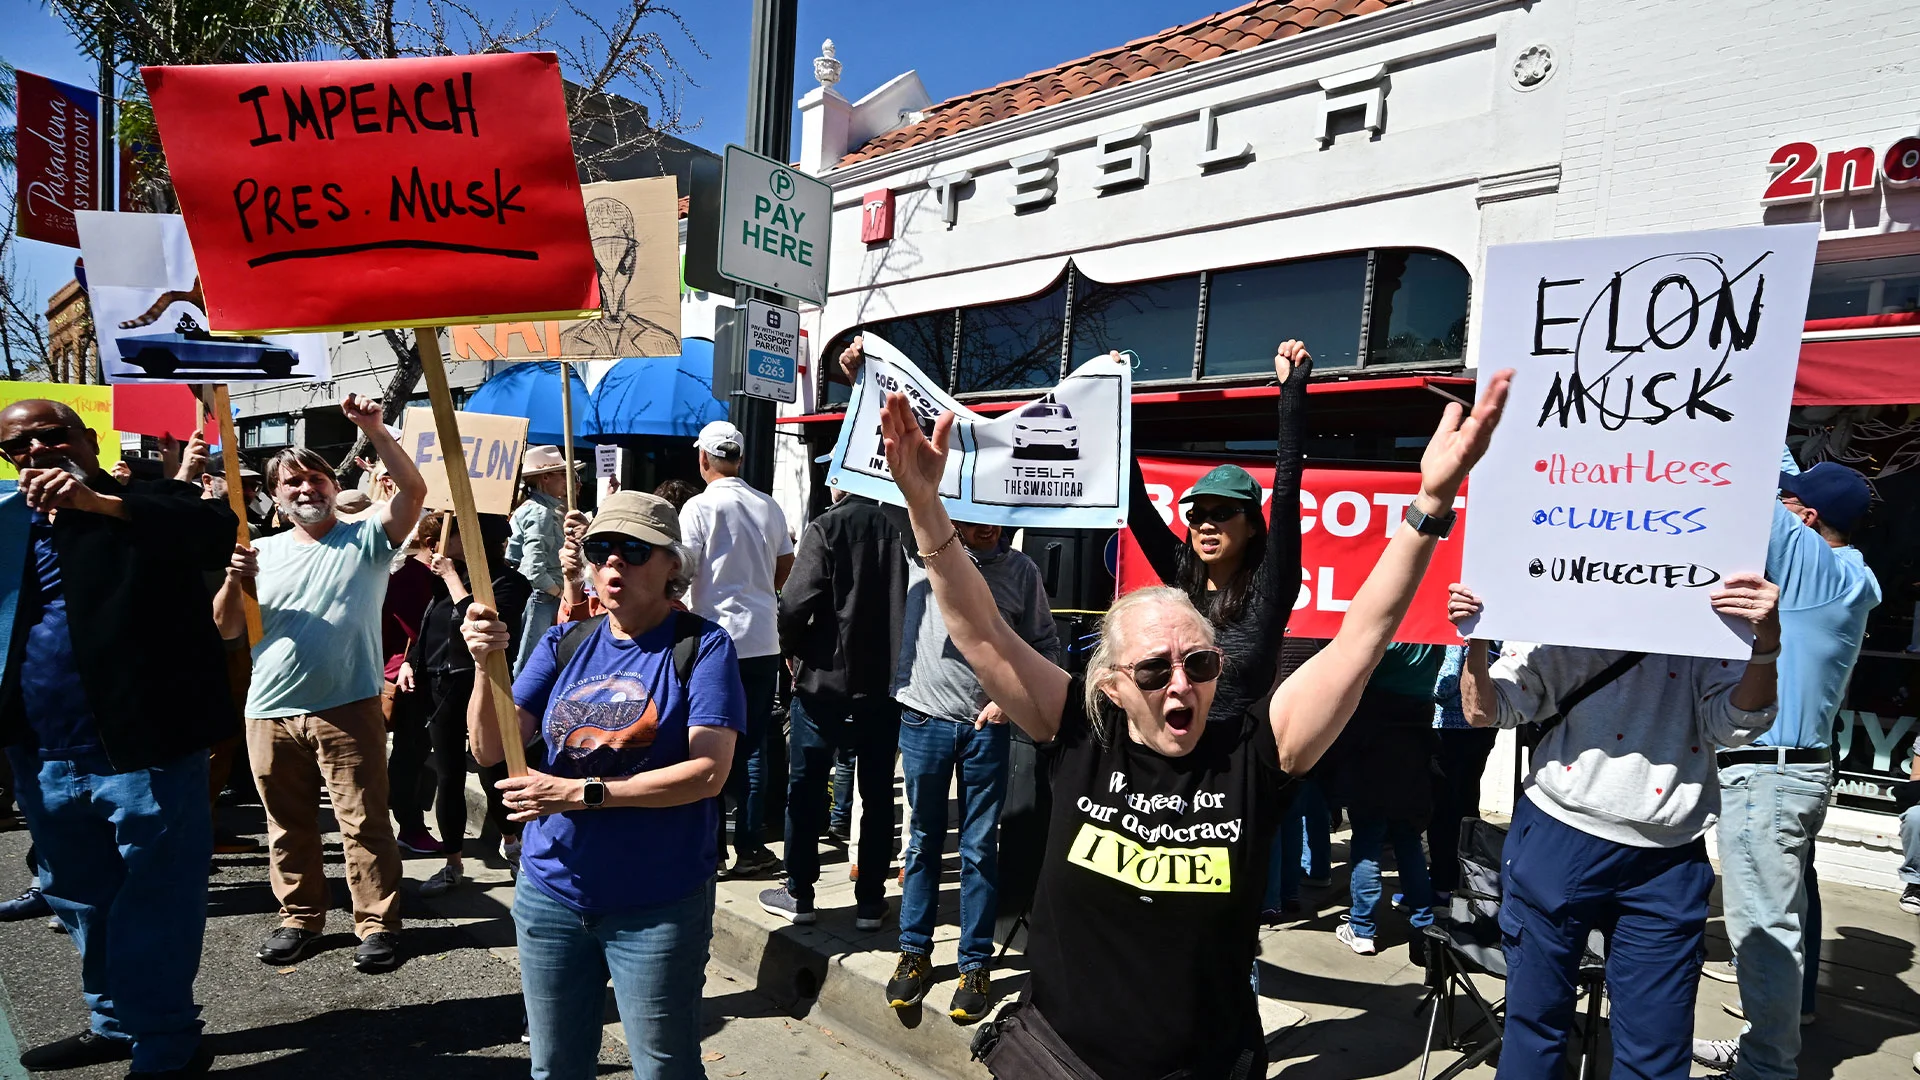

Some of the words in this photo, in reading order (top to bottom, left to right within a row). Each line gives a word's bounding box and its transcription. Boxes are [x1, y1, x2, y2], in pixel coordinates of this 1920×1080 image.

[239, 72, 479, 147] IMPEACH
[26, 96, 74, 216] Pasadena
[75, 108, 90, 209] SYMPHONY
[929, 62, 1391, 224] TESLA
[755, 194, 806, 234] PAY
[742, 220, 814, 267] HERE
[753, 331, 792, 347] PASSPORT
[755, 340, 790, 355] PARKING
[758, 363, 785, 378] 6263
[762, 355, 781, 366] ZONE
[1537, 368, 1735, 431] MUSK
[869, 457, 884, 472] IN
[1012, 466, 1075, 479] TESLA
[1548, 506, 1707, 535] CLUELESS
[1551, 556, 1721, 588] UNELECTED
[578, 677, 589, 686] OF
[591, 673, 608, 681] THE
[1109, 771, 1151, 814] Wth
[1150, 794, 1189, 815] fear
[1193, 789, 1226, 813] for
[1077, 796, 1118, 823] our
[1083, 834, 1105, 863] I
[1116, 840, 1222, 886] VOTE.
